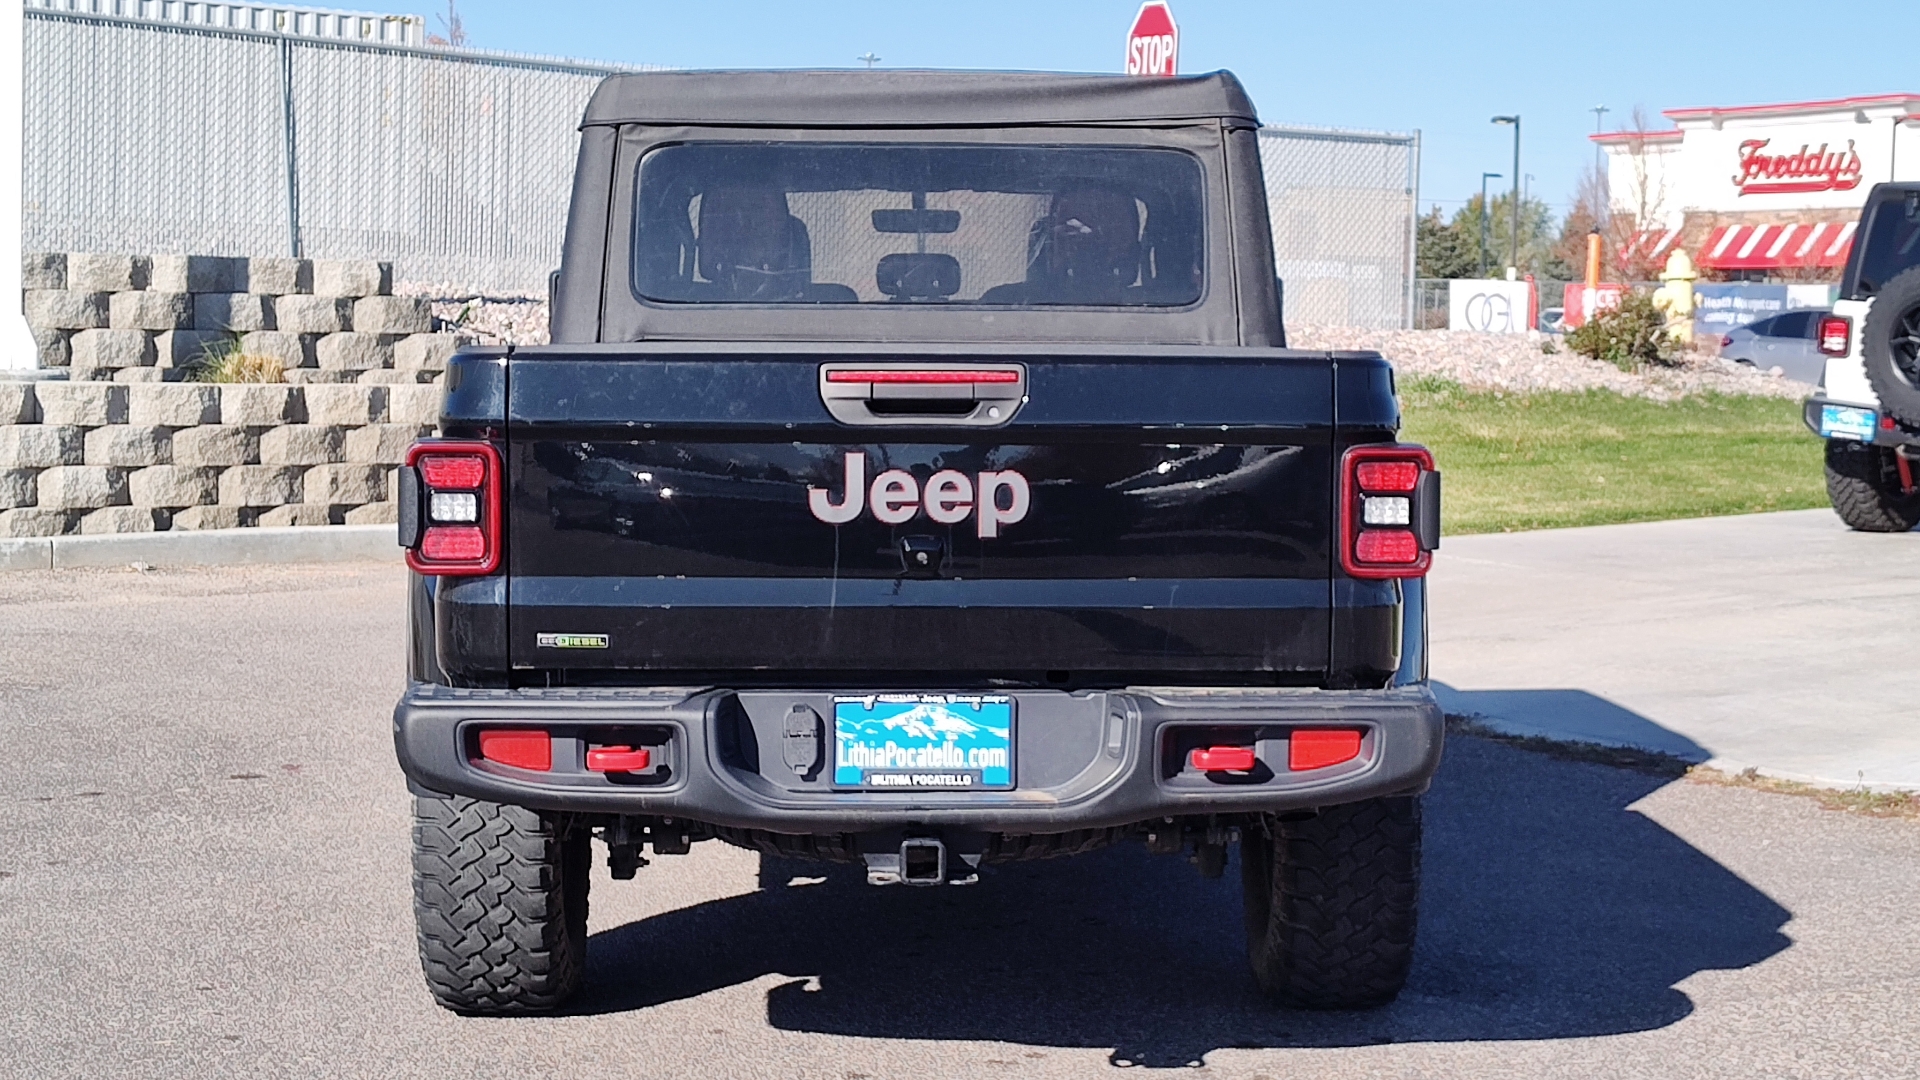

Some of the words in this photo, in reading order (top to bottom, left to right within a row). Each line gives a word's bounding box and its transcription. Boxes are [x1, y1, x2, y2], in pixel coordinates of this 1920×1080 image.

[1129, 35, 1174, 75] STOP
[1732, 138, 1863, 194] Freddy's
[808, 452, 1030, 539] Jeep
[838, 741, 1006, 768] LithiaPocatello.com
[912, 774, 972, 786] POCATELLO
